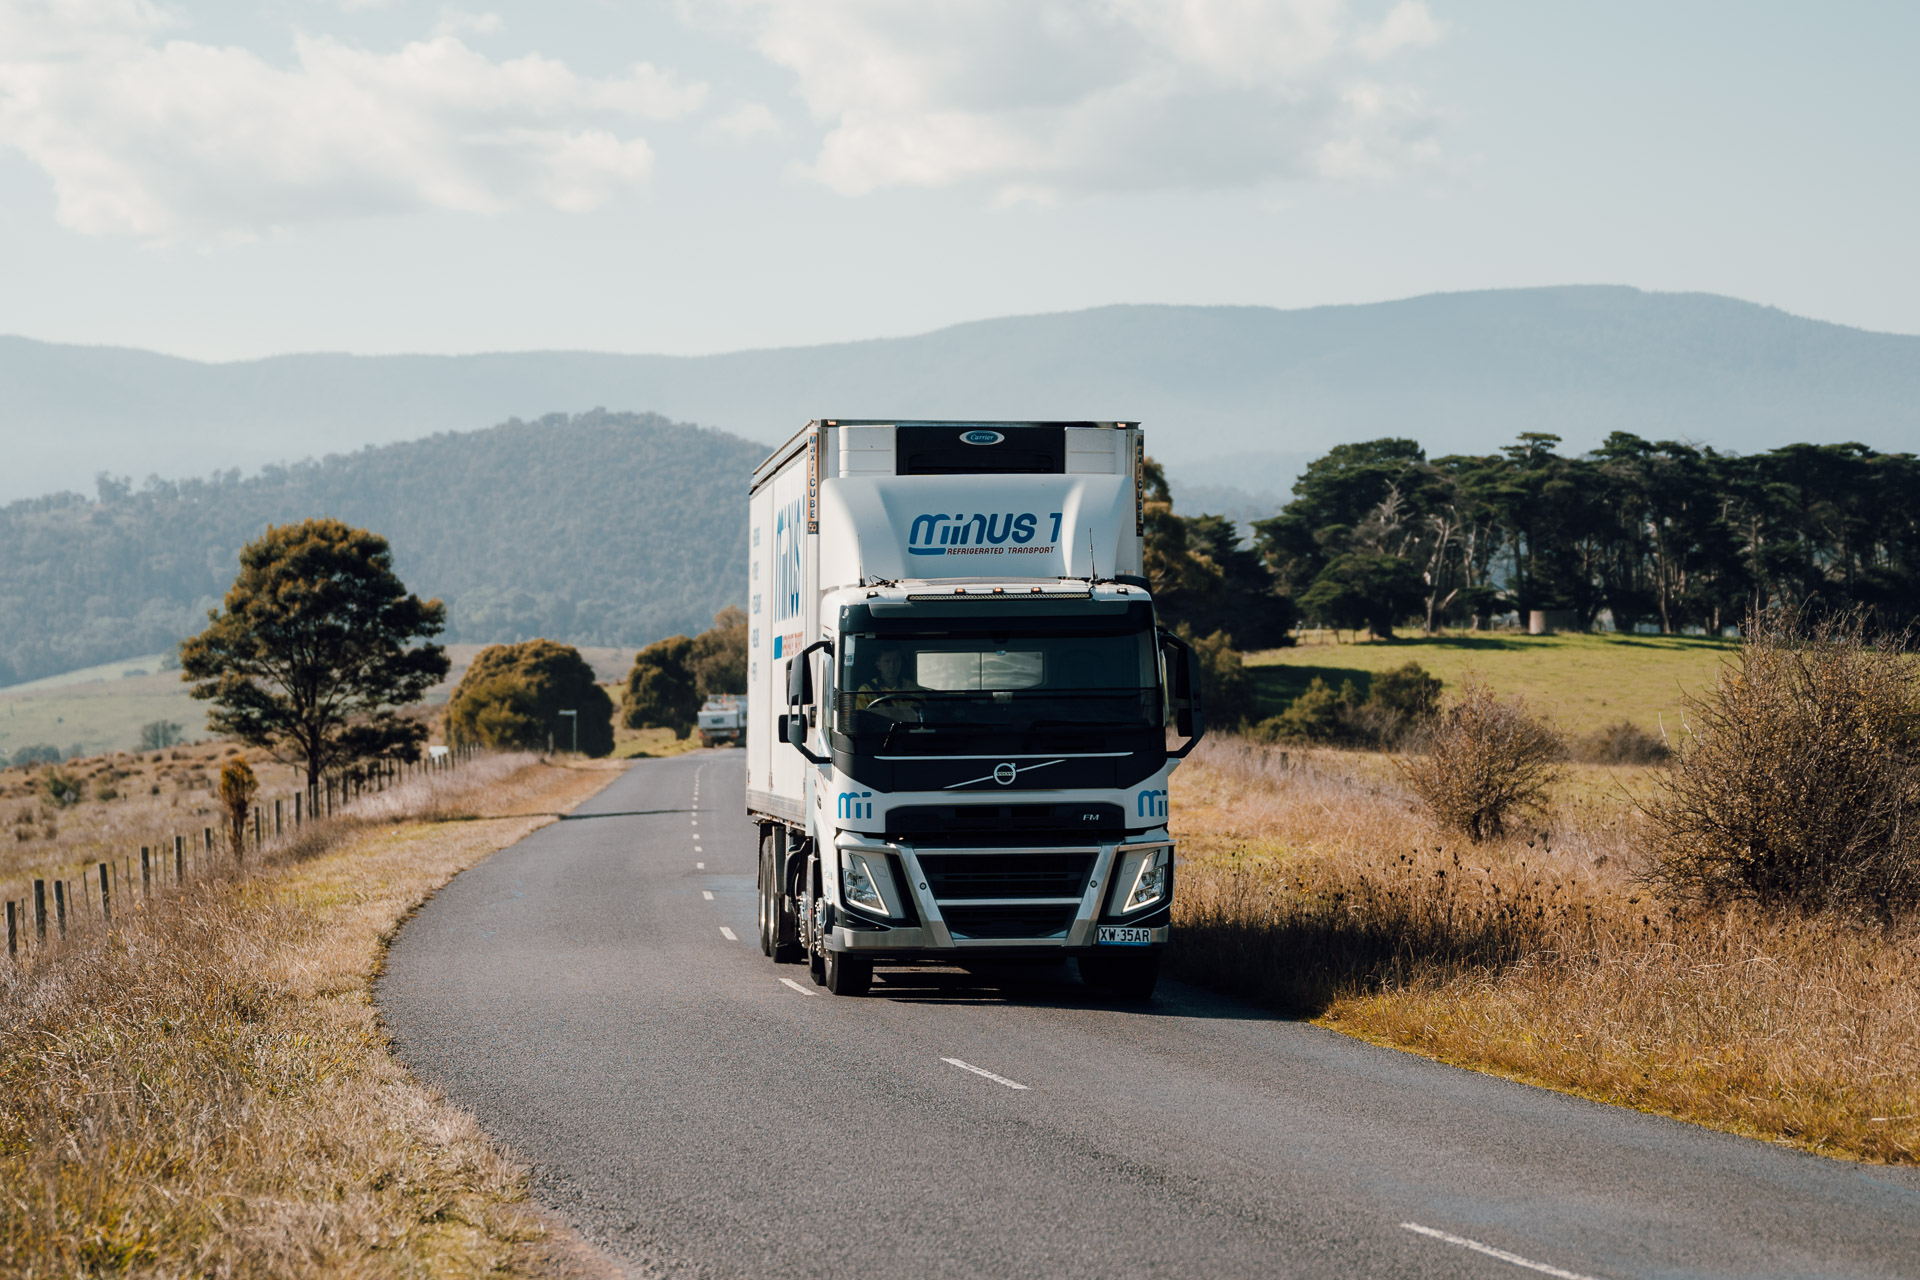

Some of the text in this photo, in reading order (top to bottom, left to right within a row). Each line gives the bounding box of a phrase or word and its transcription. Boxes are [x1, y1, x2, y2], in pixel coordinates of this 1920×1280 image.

[1049, 512, 1063, 543] 1
[947, 546, 1055, 555] REFRIGERATED TRANSPORT
